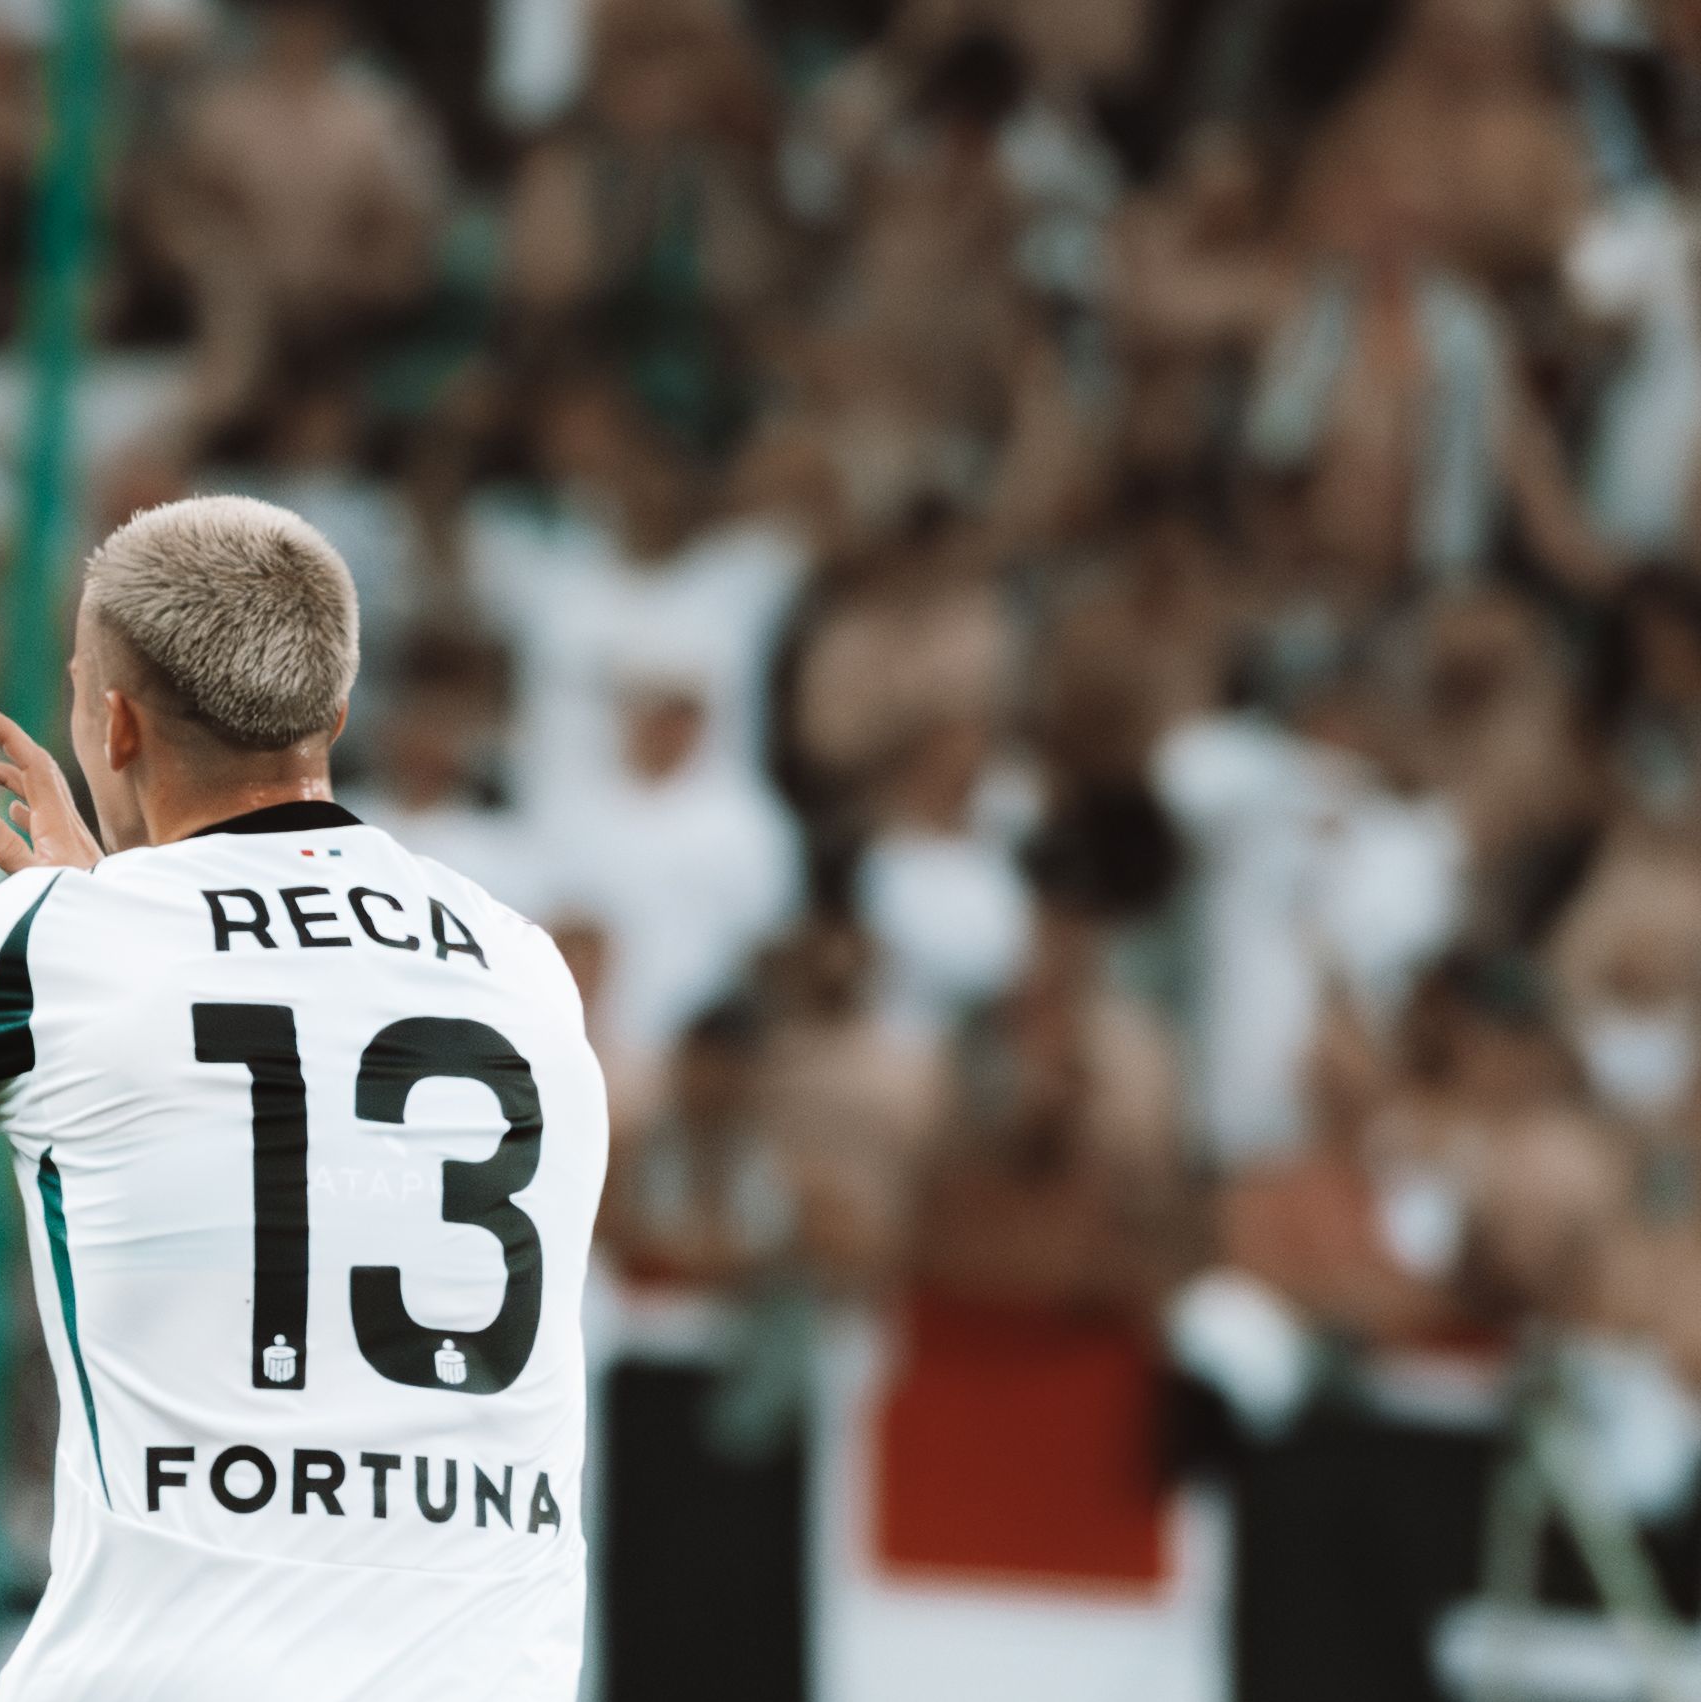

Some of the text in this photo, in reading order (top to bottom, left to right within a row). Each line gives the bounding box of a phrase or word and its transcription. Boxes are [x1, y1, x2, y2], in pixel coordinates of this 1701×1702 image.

[200, 885, 490, 970] RECA
[191, 1002, 544, 1396] 13
[144, 1444, 562, 1538] FORTUNA
